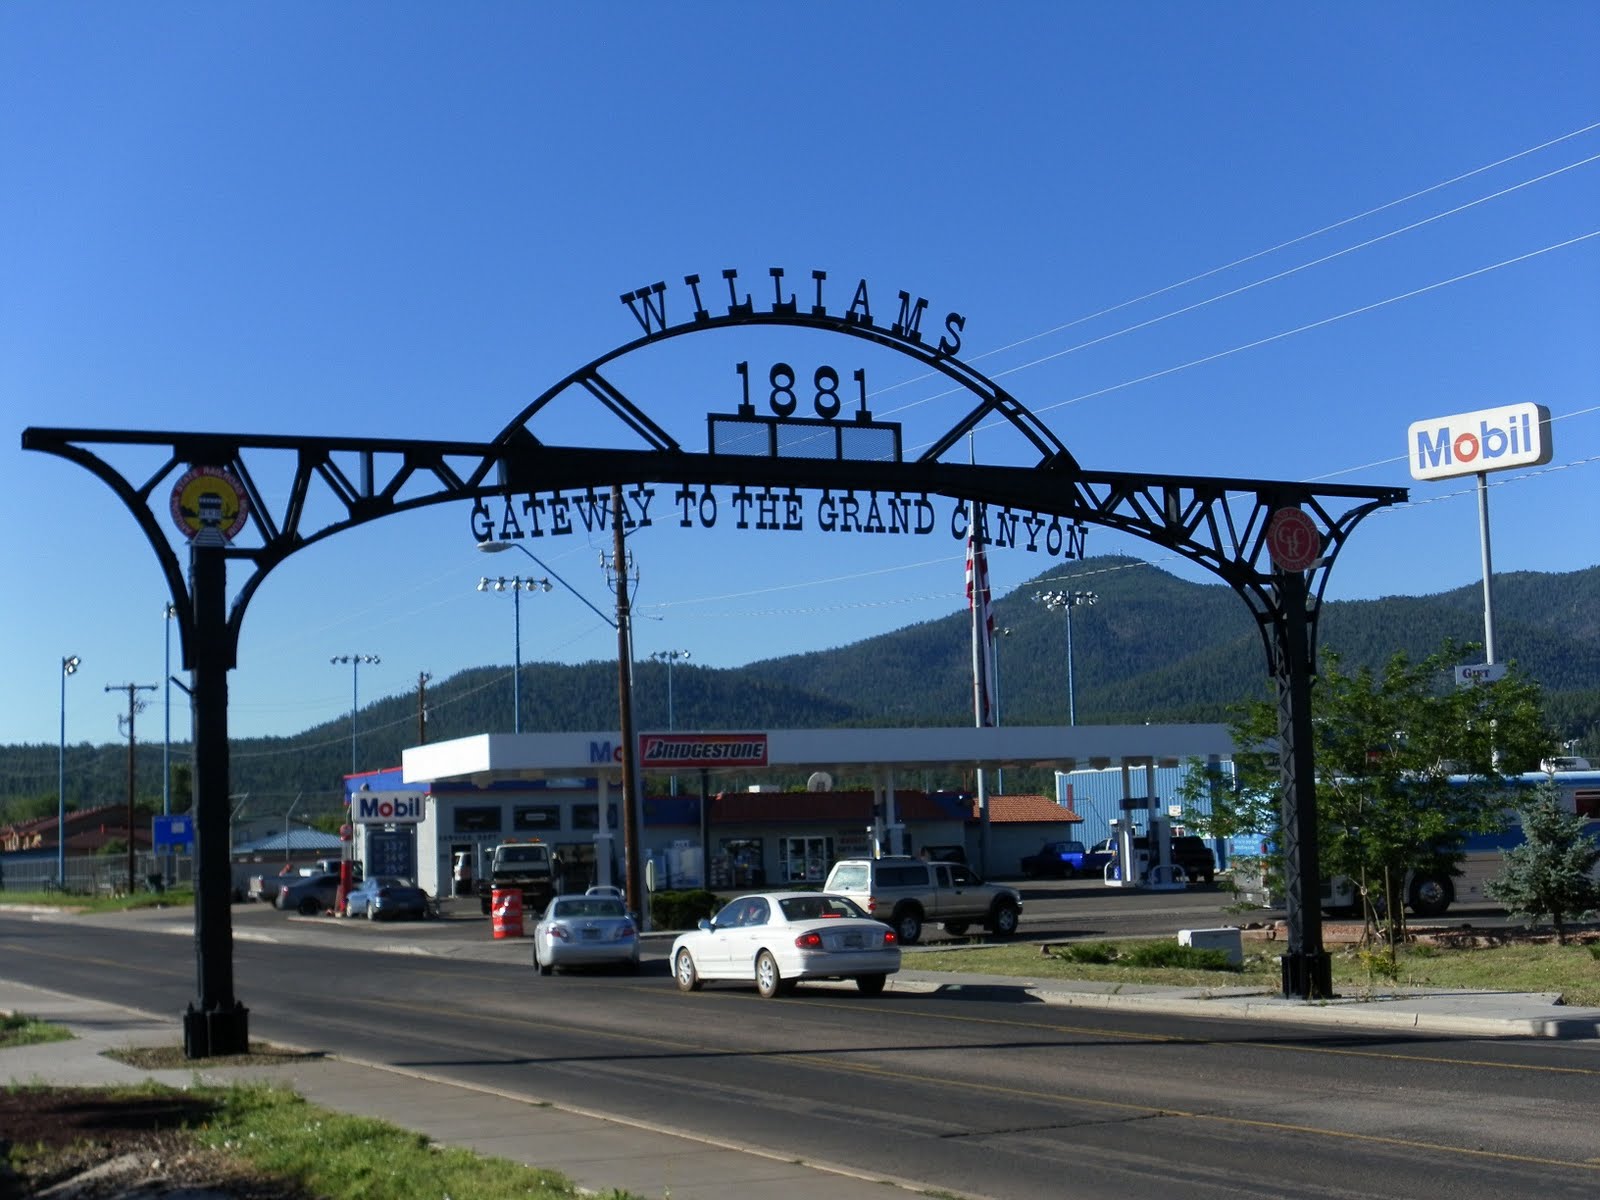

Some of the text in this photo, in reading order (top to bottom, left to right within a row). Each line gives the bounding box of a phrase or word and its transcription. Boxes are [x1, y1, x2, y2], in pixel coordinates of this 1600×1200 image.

[620, 268, 966, 359] WILLIAMS
[736, 361, 873, 422] 1881
[1417, 413, 1531, 469] Mobil
[470, 489, 1089, 561] GATEWAY TO THE GRAND CANYON
[646, 739, 765, 760] BRIDGESTONE
[360, 797, 420, 817] Mobil
